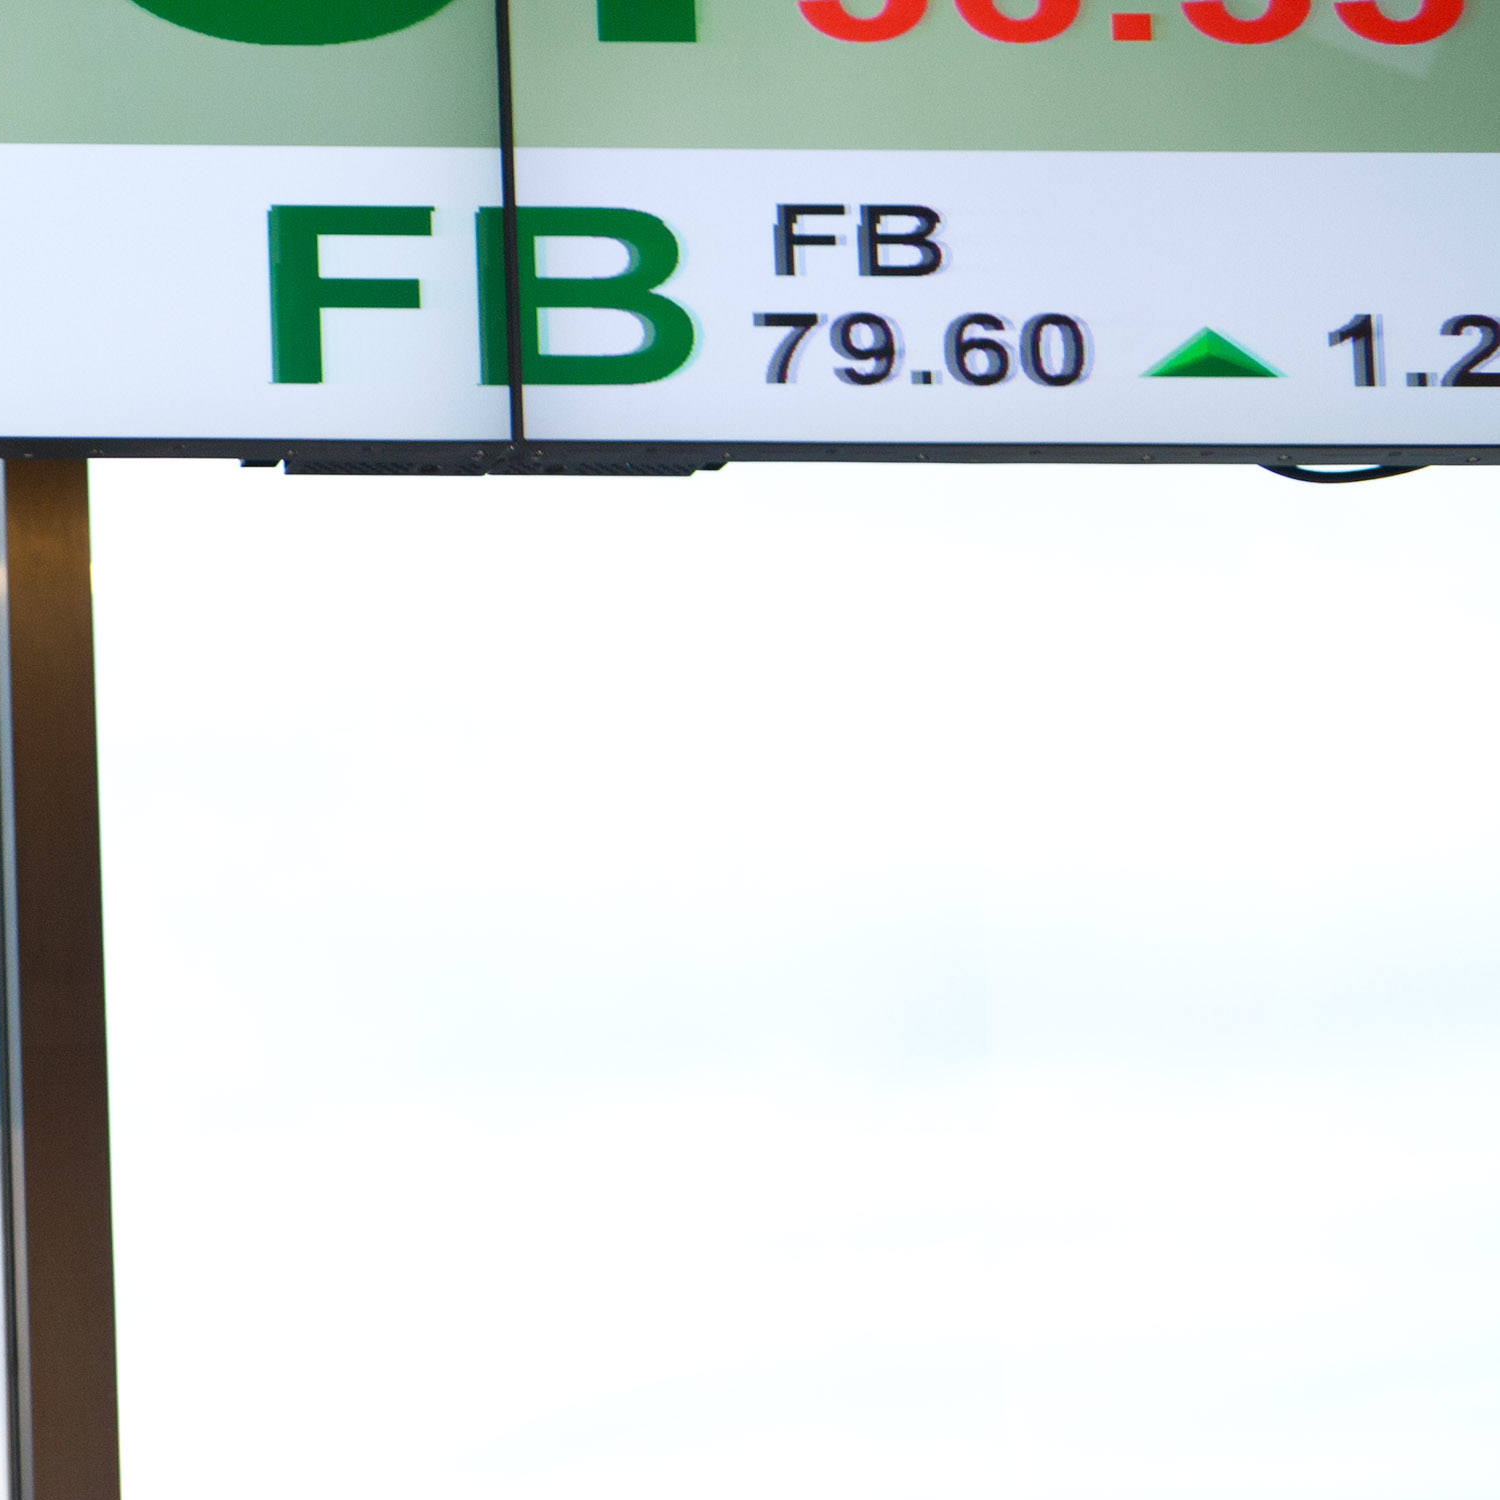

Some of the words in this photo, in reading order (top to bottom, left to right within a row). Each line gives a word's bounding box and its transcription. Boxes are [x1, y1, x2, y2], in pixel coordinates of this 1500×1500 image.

[772, 203, 946, 277] FB
[267, 204, 697, 386] FB
[752, 311, 1088, 388] 79.60
